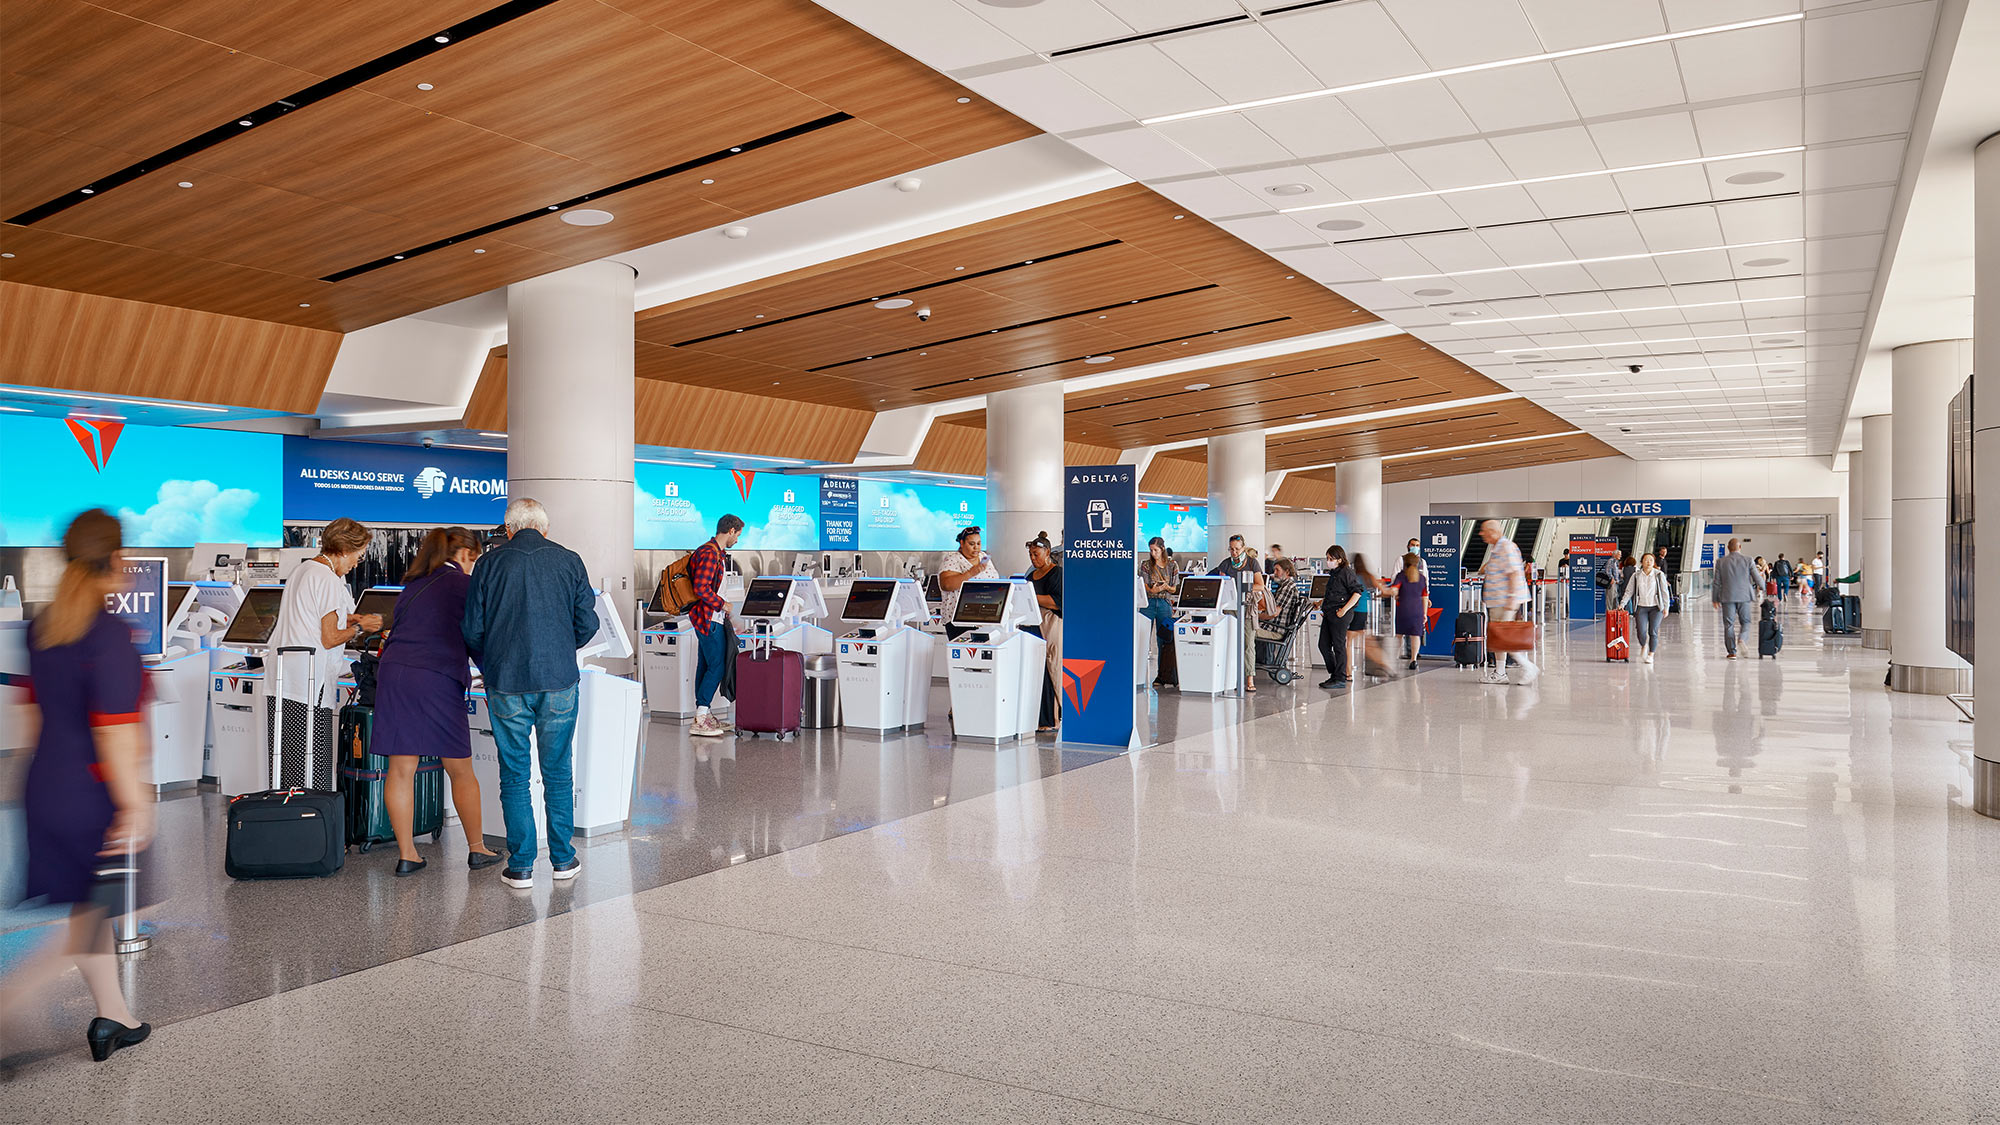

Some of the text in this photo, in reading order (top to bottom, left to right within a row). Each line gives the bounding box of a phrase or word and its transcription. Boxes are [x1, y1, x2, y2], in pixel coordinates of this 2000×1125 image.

[300, 468, 405, 483] ALL DESKS ALSO SERVE
[1082, 475, 1118, 483] DELTA
[829, 481, 850, 489] DELTA
[652, 499, 691, 508] SELF-TAGGED
[773, 505, 805, 513] SELF-TAGGED
[1576, 502, 1662, 514] ALL GATES
[656, 508, 687, 517] BAG DROP
[825, 520, 853, 528] THANK YOU
[826, 527, 836, 535] FOR
[1074, 540, 1124, 549] CHECK-IN &
[1065, 550, 1133, 559] TAG BAGS HERE
[122, 566, 144, 574] ELTA
[104, 592, 155, 614] EXIT
[482, 754, 497, 762] DEL
